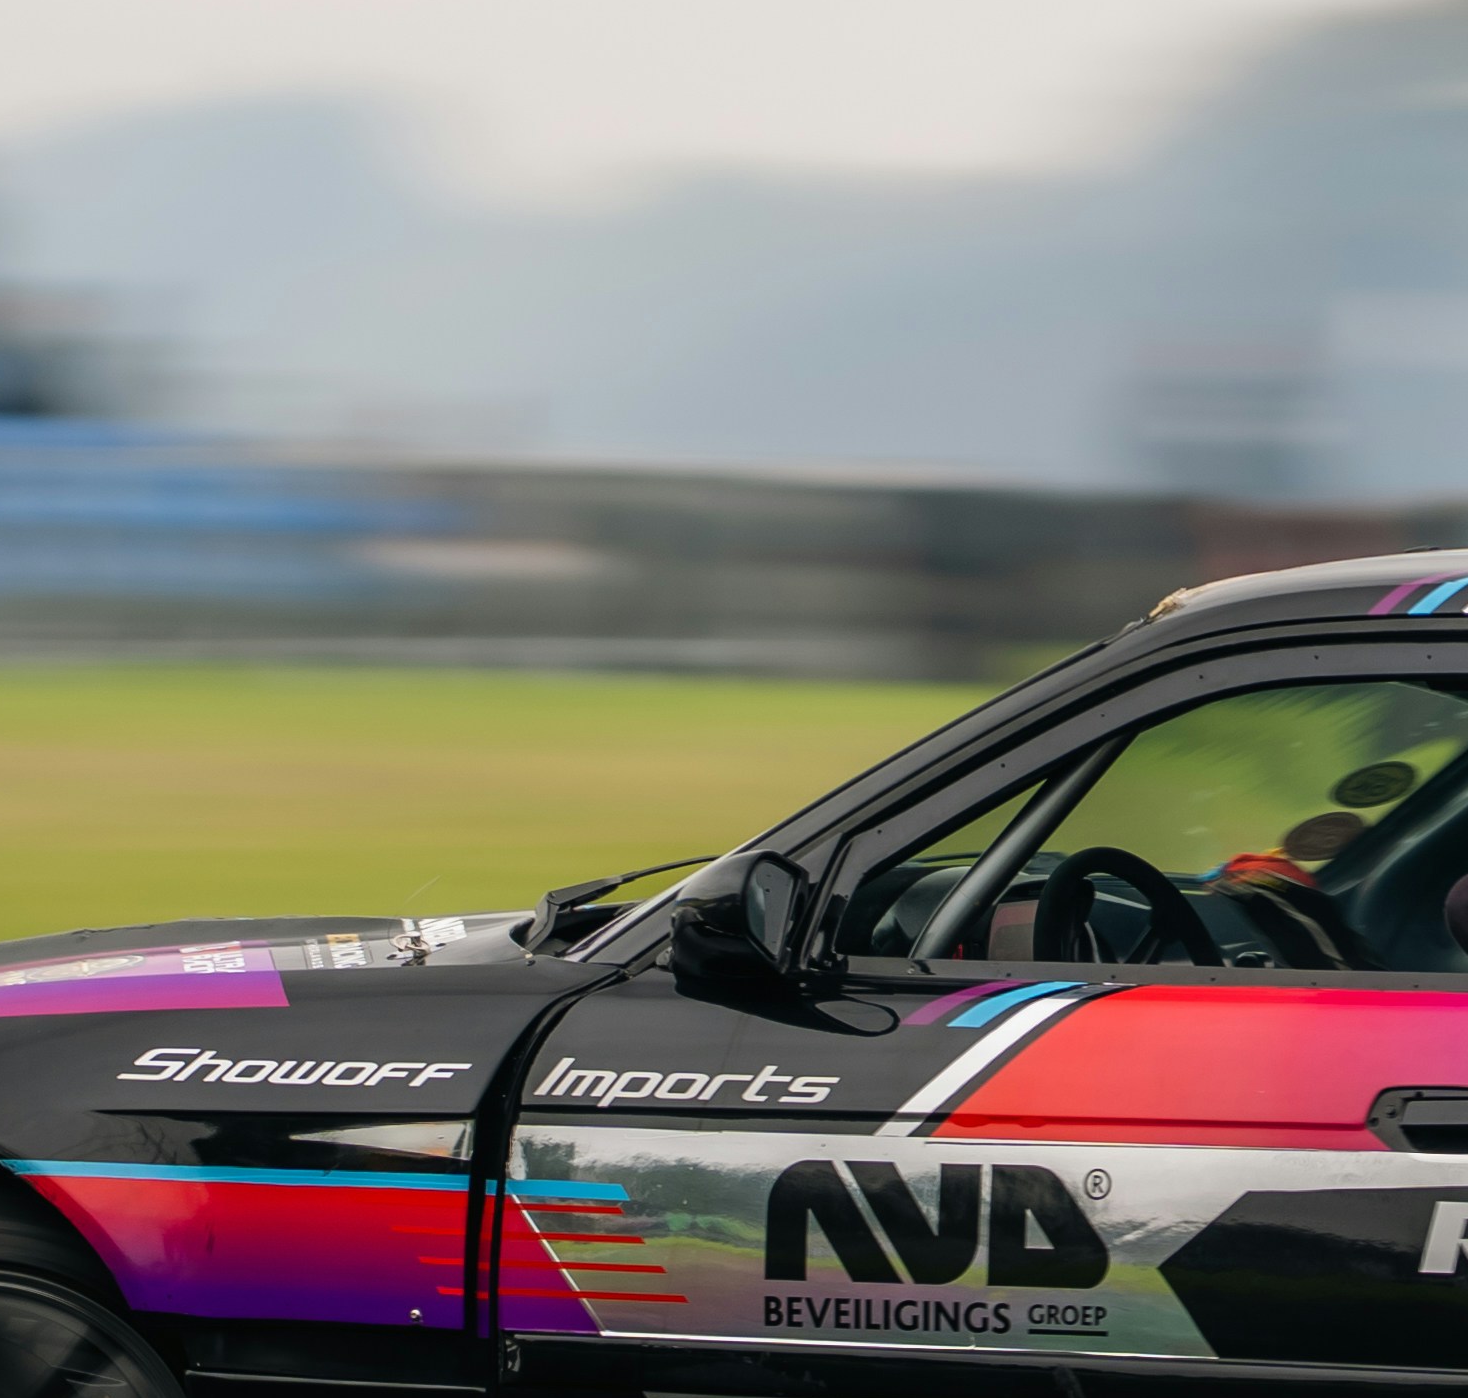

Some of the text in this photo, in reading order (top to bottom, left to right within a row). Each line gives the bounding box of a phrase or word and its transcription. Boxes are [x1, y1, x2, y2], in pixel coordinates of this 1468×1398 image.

[533, 1058, 839, 1107] Imports
[764, 1296, 1108, 1334] BEVEILIGINGS GROEP
